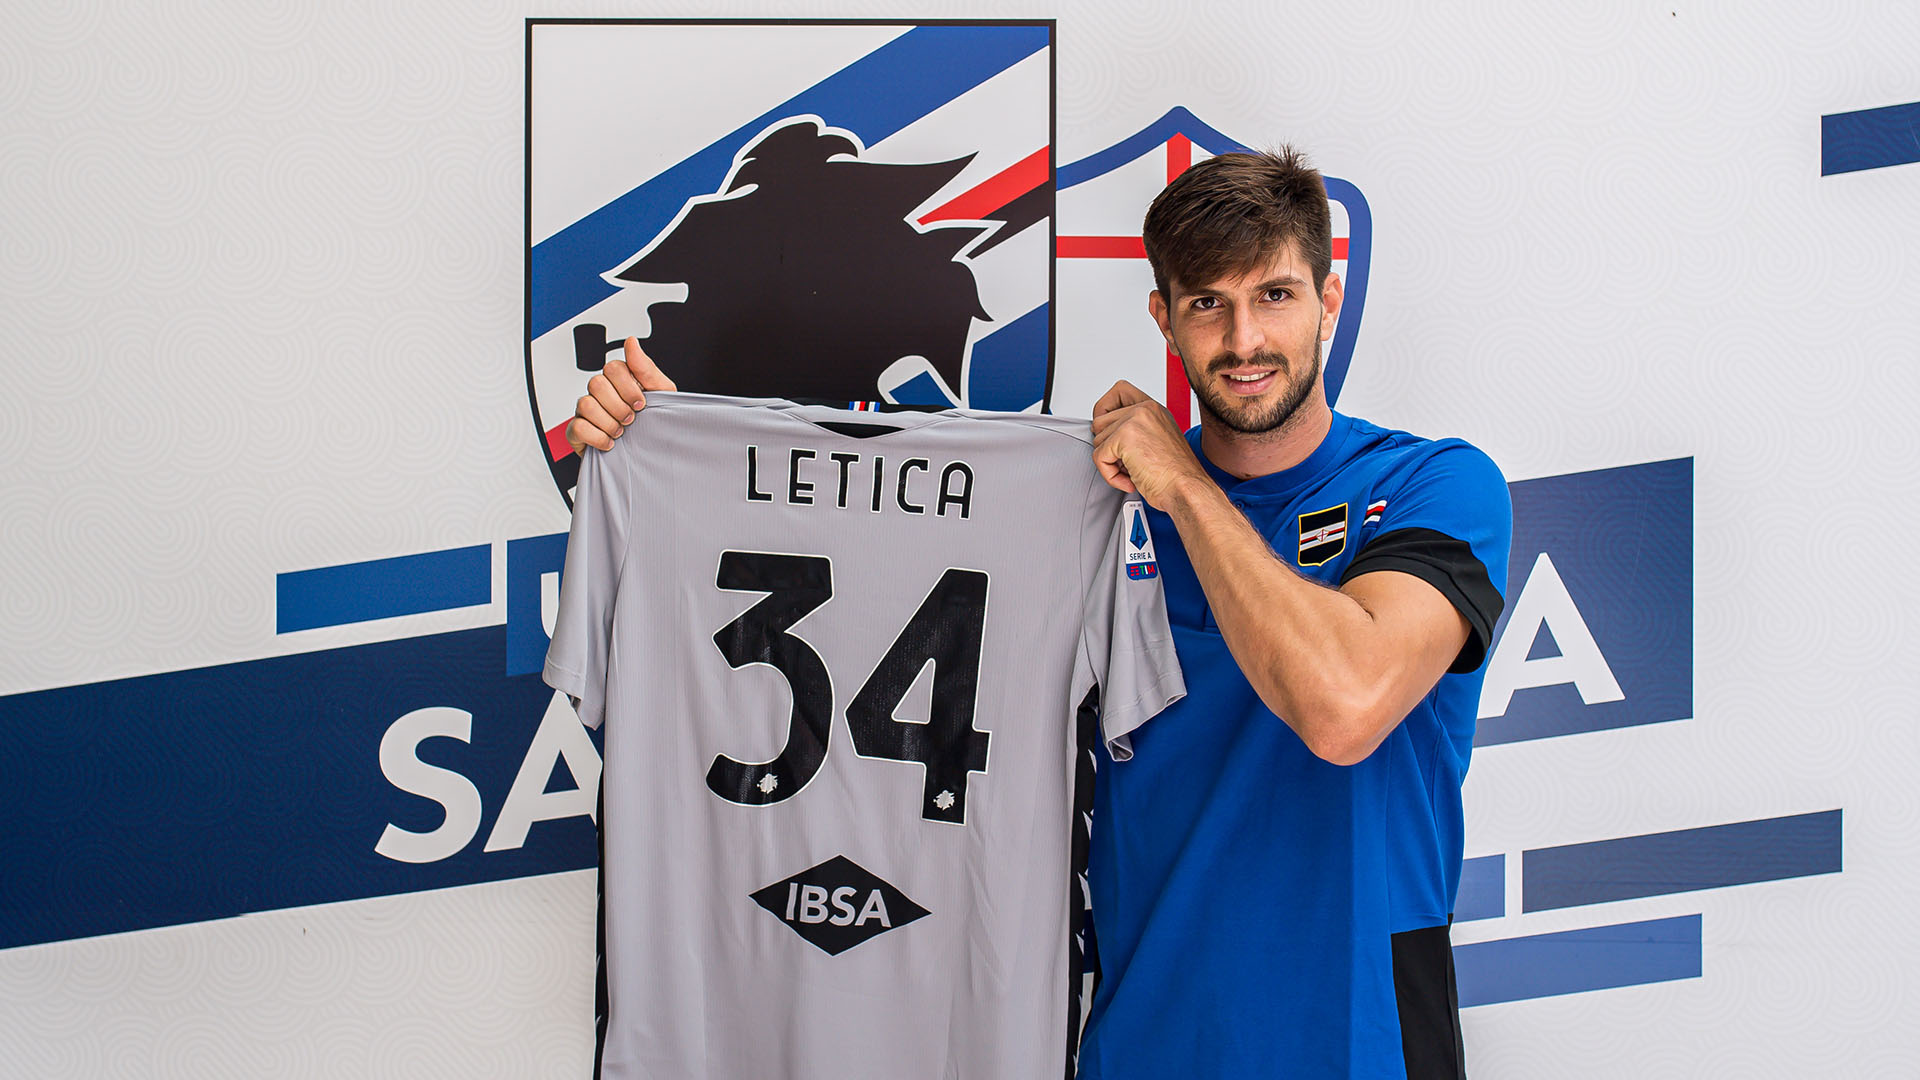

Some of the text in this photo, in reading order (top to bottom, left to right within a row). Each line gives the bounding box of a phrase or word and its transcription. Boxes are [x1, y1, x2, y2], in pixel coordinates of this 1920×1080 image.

[745, 444, 975, 520] LETICA
[1129, 552, 1152, 561] SERIE A
[1139, 564, 1156, 575] TIM
[705, 549, 992, 826] 34
[785, 882, 892, 928] IBSA
